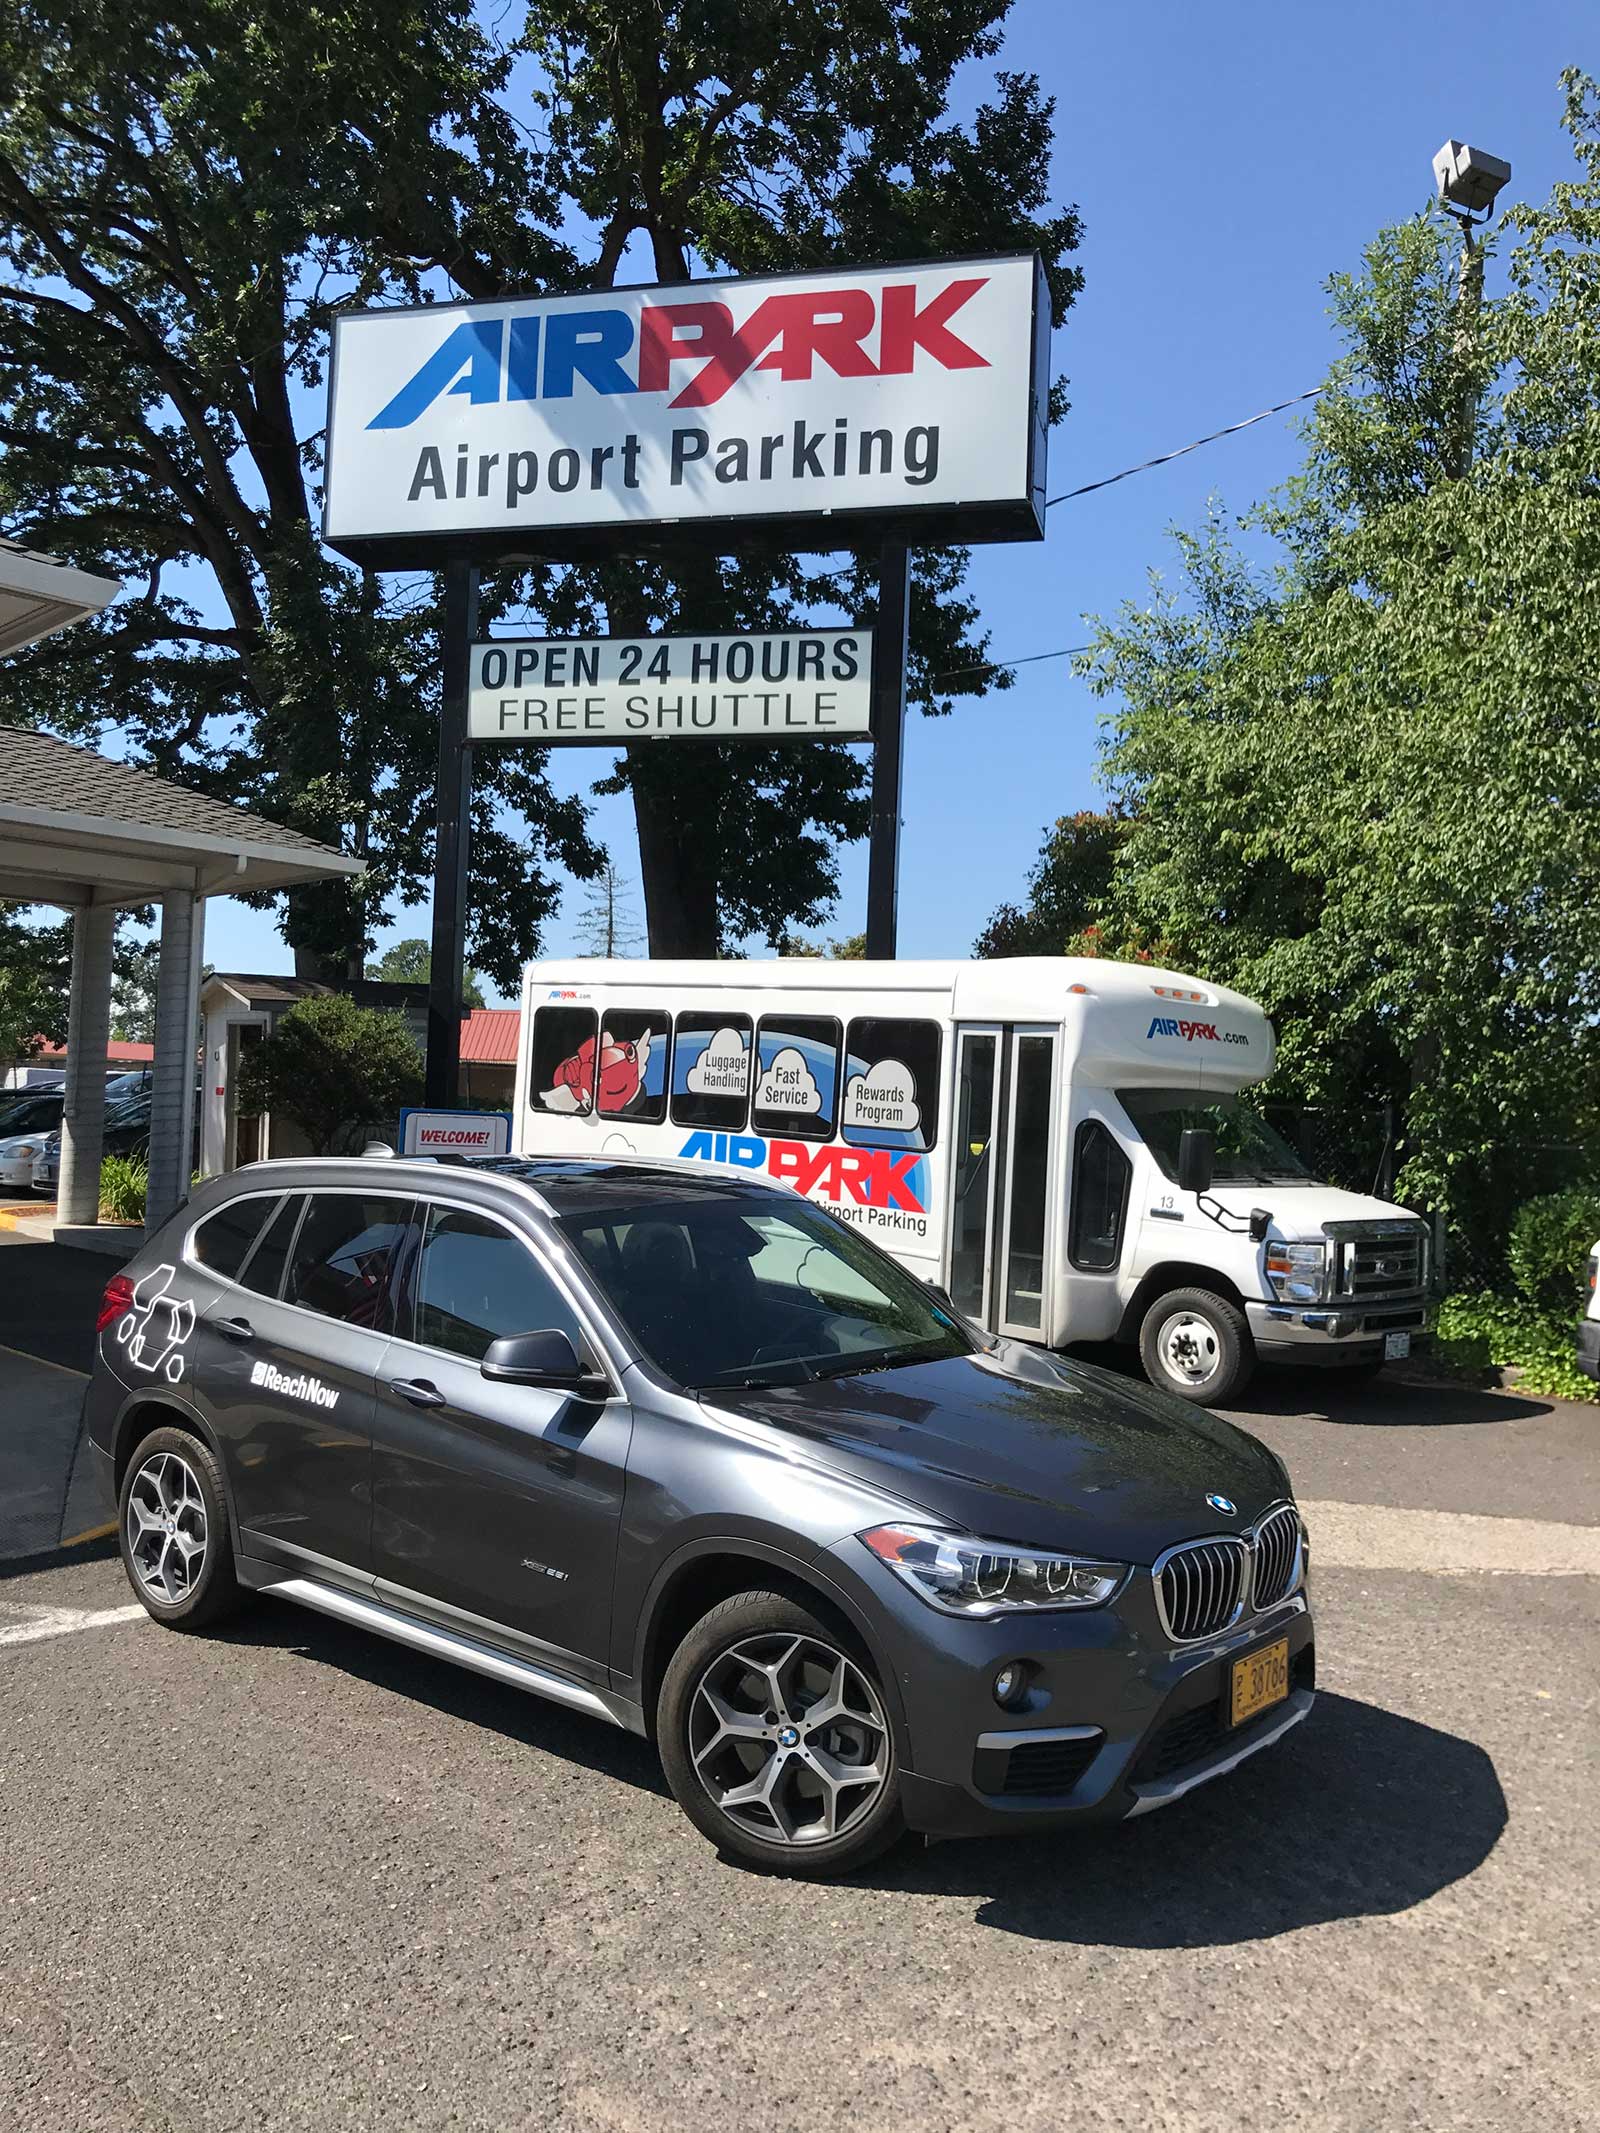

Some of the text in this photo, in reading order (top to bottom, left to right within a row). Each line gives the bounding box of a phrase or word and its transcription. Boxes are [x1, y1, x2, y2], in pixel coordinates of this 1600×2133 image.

[363, 278, 992, 430] AIRPARK
[407, 418, 941, 509] Airport Parking
[481, 638, 858, 690] OPEN 24 HOURS
[499, 692, 837, 731] FREE SHUTTLE
[705, 1053, 747, 1071] Luggage
[703, 1072, 746, 1092] Handling
[775, 1067, 800, 1085] Fast
[765, 1086, 808, 1105] Service
[856, 1084, 904, 1103] Rewards
[855, 1103, 903, 1123] Program
[420, 1129, 490, 1145] WELCOME!
[1161, 1195, 1174, 1209] 13
[867, 1208, 928, 1237] Parking
[263, 1364, 341, 1409] ReachNow
